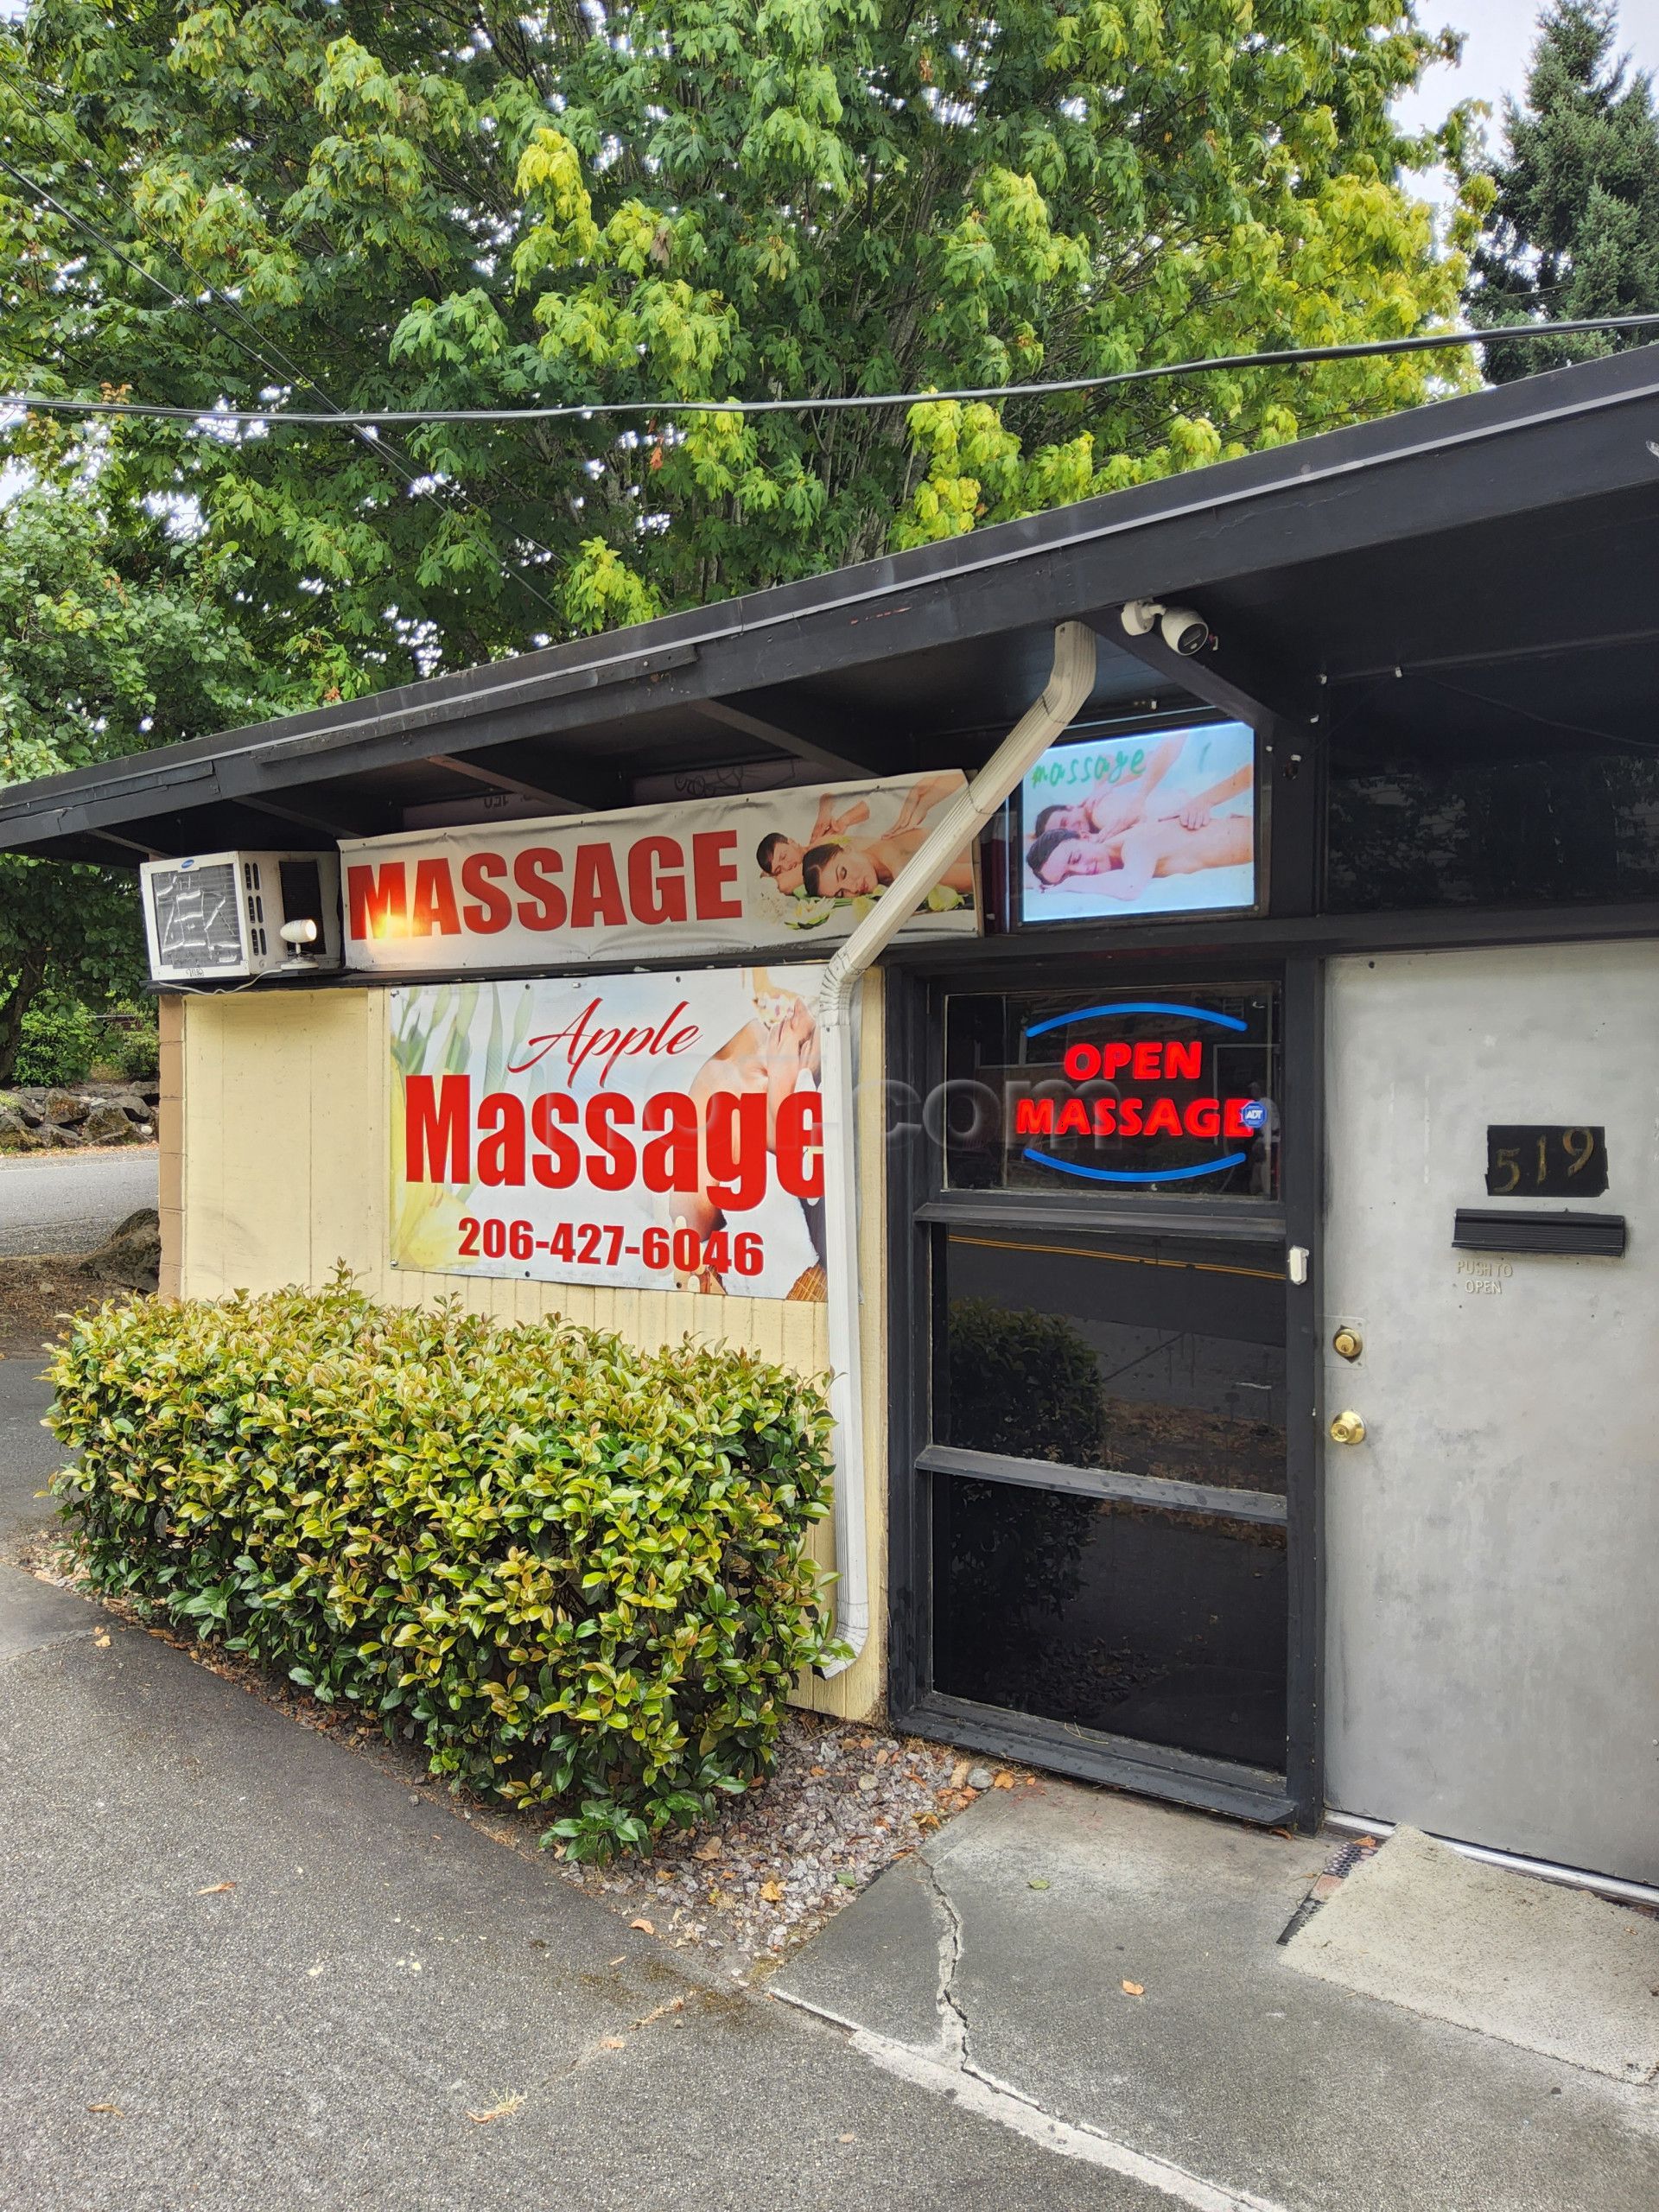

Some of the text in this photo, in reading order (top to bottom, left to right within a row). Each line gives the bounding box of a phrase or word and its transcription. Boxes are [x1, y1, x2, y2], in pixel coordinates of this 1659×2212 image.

[1031, 748, 1147, 788] massage
[349, 831, 743, 942] MASSAGE
[508, 997, 702, 1088] Apple
[1063, 1040, 1204, 1081] OPEN
[1014, 1097, 1255, 1138] MASSAGE
[1244, 1109, 1263, 1120] ADT
[404, 1073, 826, 1213] Massage
[1492, 1126, 1596, 1195] 519
[457, 1216, 764, 1278] 206-427-6046
[1456, 1260, 1514, 1278] PUSH TO
[1465, 1280, 1503, 1295] OPEN
